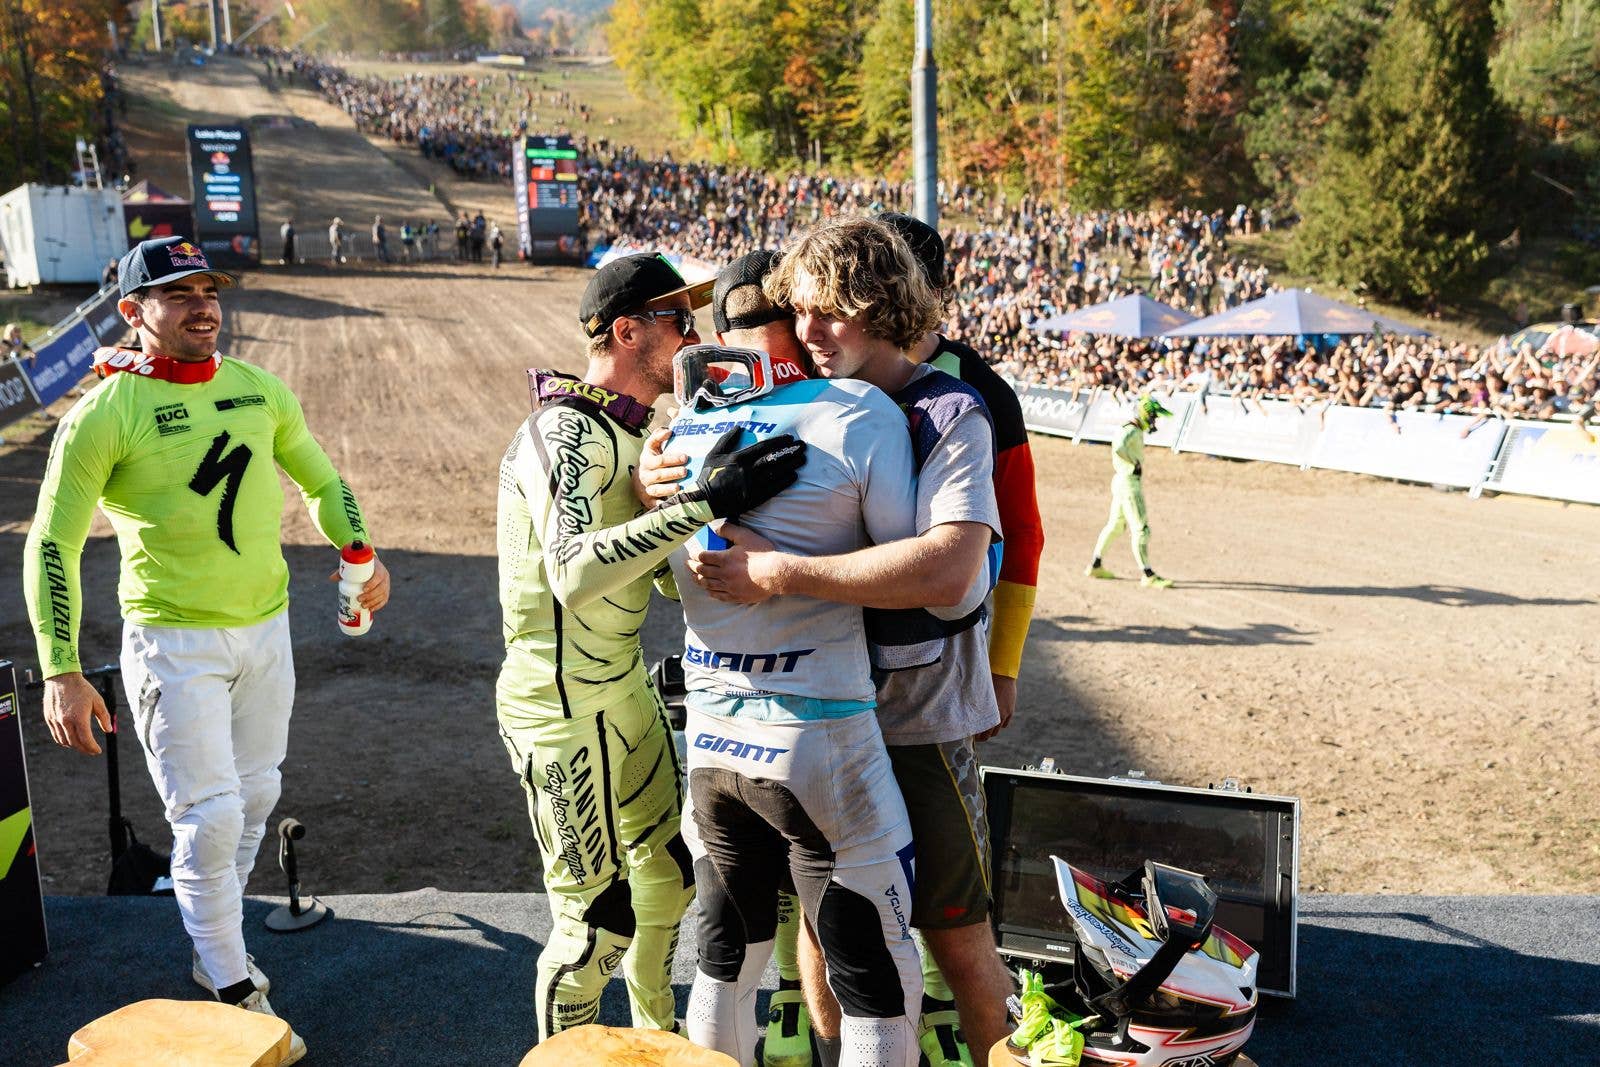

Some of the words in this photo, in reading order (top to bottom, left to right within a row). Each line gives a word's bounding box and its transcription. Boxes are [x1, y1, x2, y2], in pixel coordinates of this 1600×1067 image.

[544, 377, 619, 407] OAKLEY
[161, 408, 189, 422] UCI
[592, 516, 707, 565] CANYON
[685, 644, 817, 673] GIANT
[693, 733, 790, 764] GIANT
[543, 761, 567, 798] Troy
[551, 796, 570, 827] Lee
[569, 746, 607, 876] CANYON
[558, 825, 587, 886] Designs
